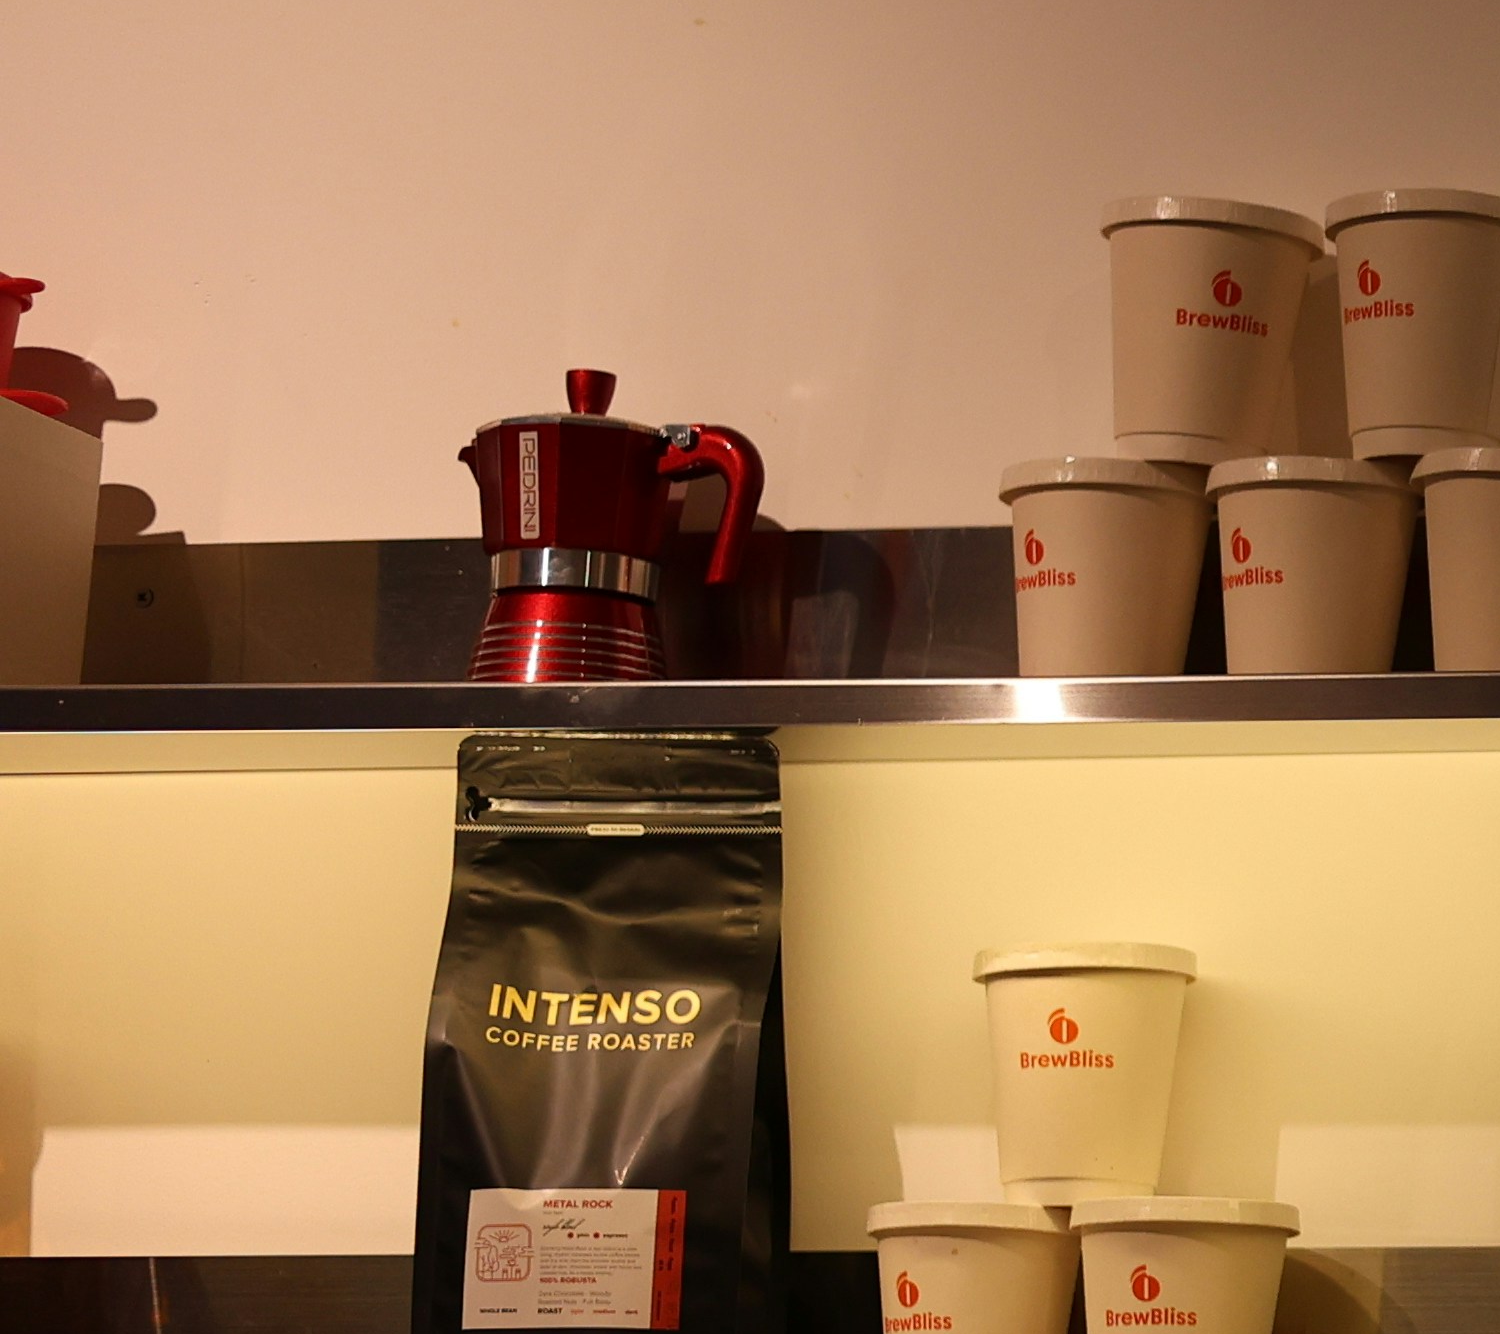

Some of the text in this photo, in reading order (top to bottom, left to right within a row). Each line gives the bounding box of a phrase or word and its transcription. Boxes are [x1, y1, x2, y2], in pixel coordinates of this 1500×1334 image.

[1176, 307, 1269, 338] BrewBliss
[522, 437, 537, 533] PEDRINI
[488, 982, 703, 1027] INTENSO
[485, 1026, 695, 1053] COFFEE ROASTER
[1019, 1049, 1115, 1070] BrewBliss
[543, 1200, 614, 1209] METAL ROCK
[538, 1306, 563, 1315] ROAST
[1105, 1305, 1198, 1327] BrewBliss
